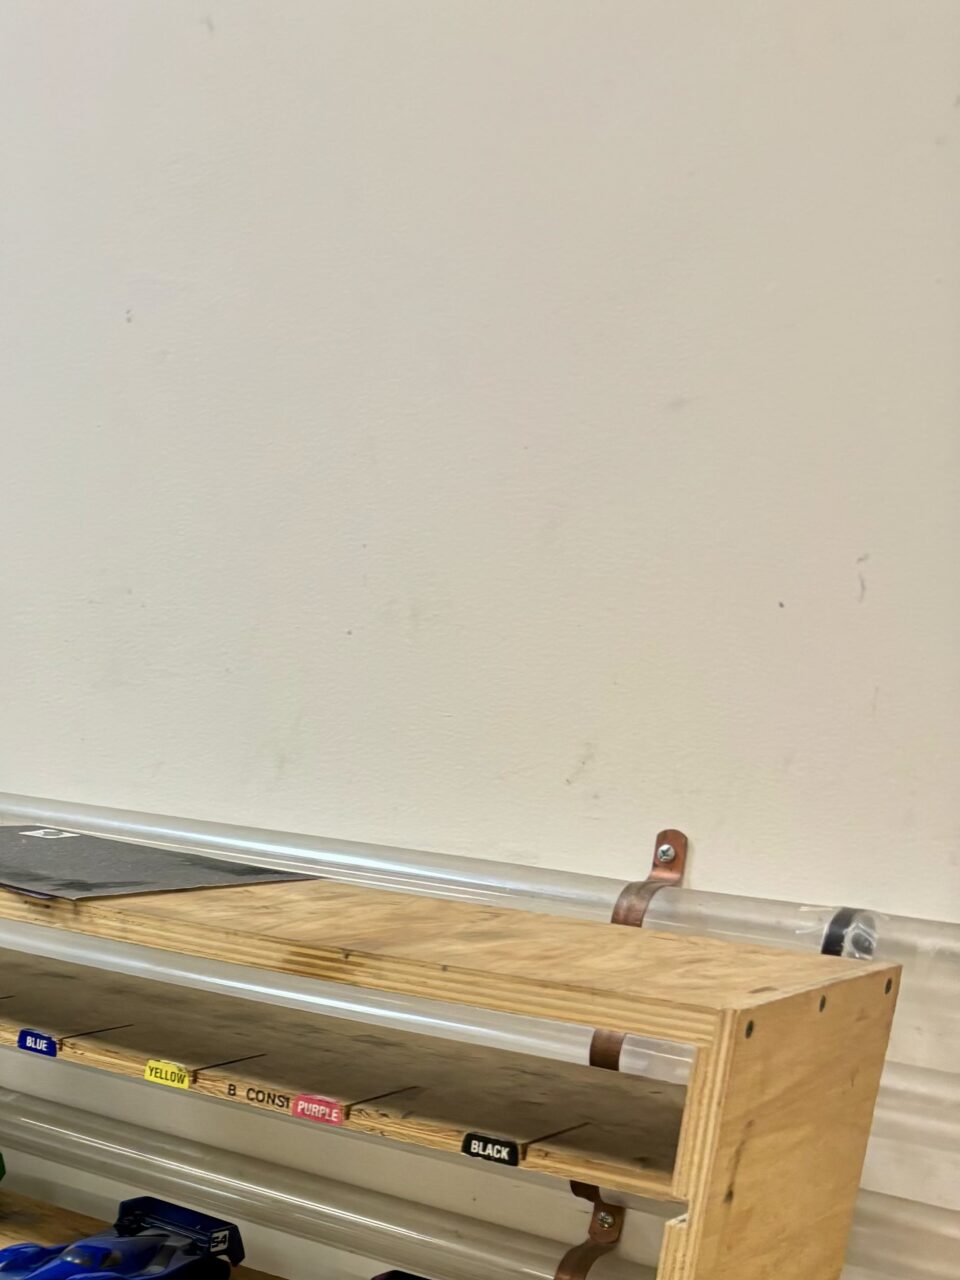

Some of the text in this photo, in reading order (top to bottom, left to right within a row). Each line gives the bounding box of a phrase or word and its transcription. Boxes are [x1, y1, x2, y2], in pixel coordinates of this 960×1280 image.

[26, 1036, 48, 1051] BLUE
[148, 1065, 187, 1085] YELLOW
[227, 1083, 237, 1097] B
[297, 1101, 340, 1121] PURPLE
[470, 1140, 510, 1160] BLACK
